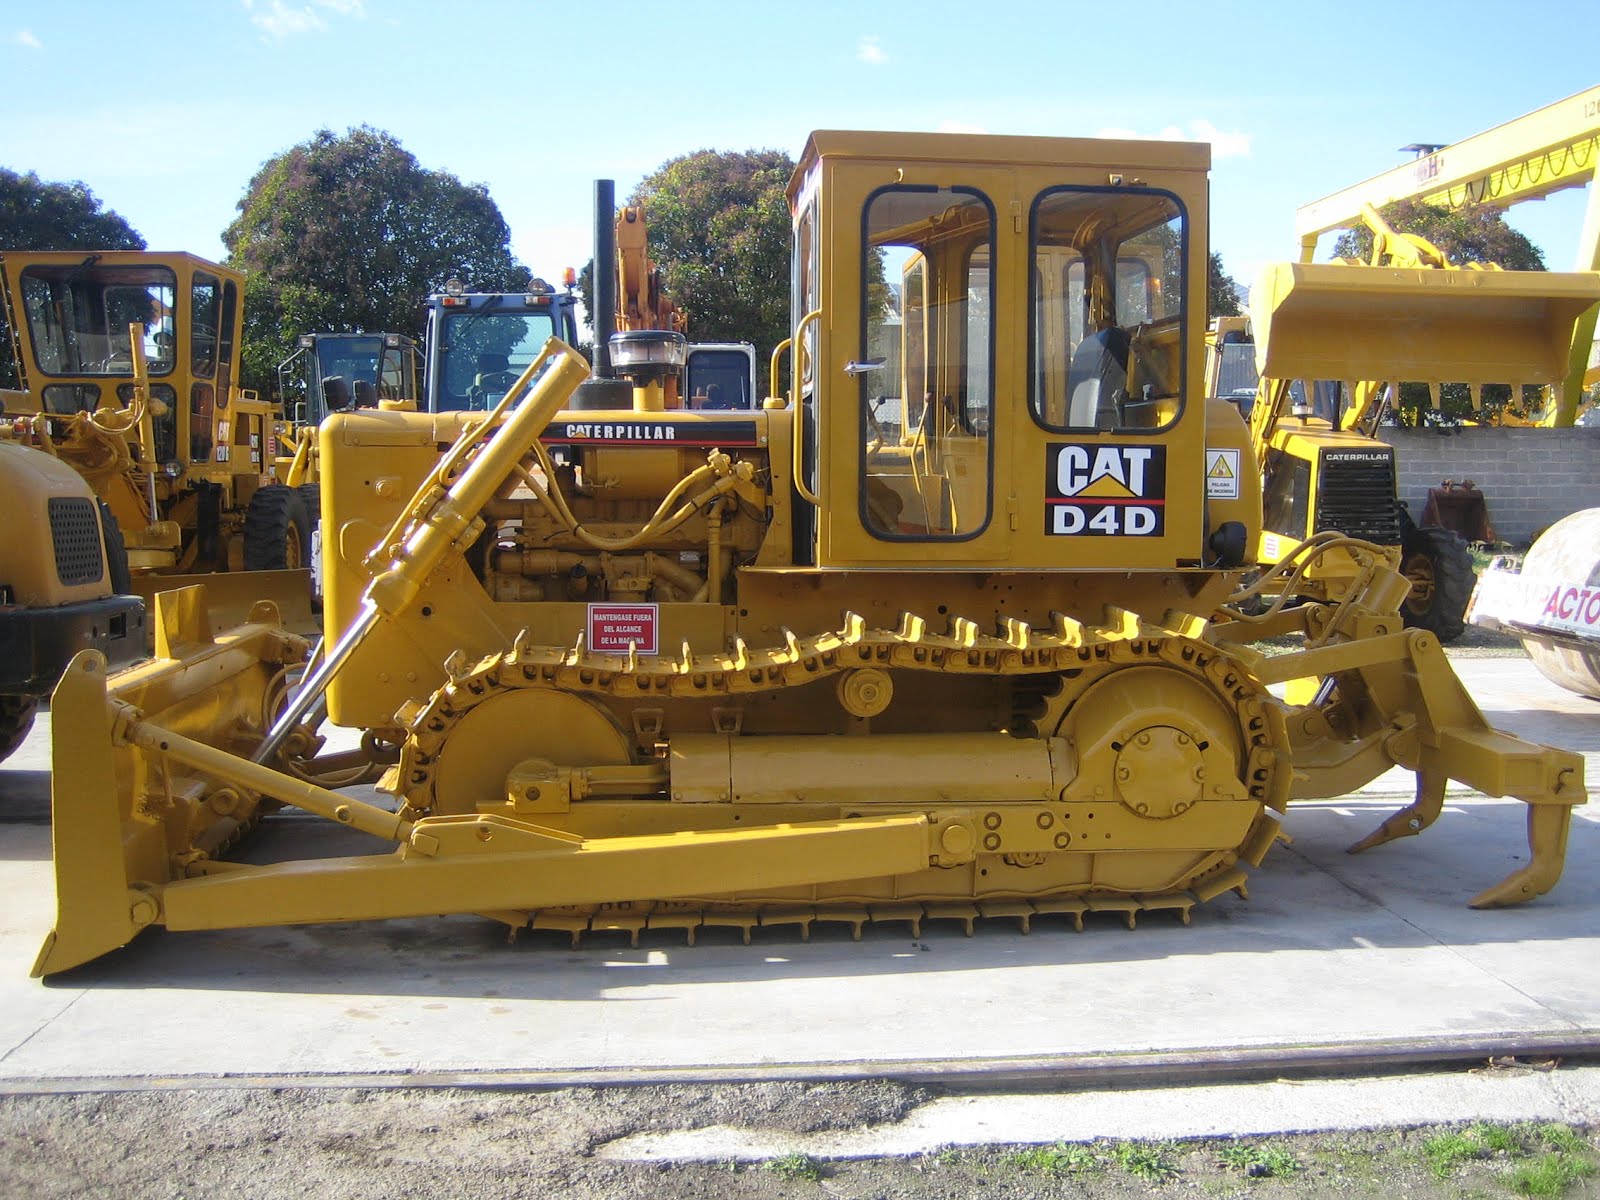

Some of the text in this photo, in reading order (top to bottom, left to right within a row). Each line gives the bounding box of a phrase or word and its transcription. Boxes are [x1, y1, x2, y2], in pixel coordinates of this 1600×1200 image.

[566, 424, 675, 440] CATERPILLAR
[1325, 453, 1389, 461] CATERPILLAR
[1057, 445, 1152, 497] CAT
[1053, 505, 1156, 535] D4D
[594, 613, 652, 621] MANTENGASE FUERA
